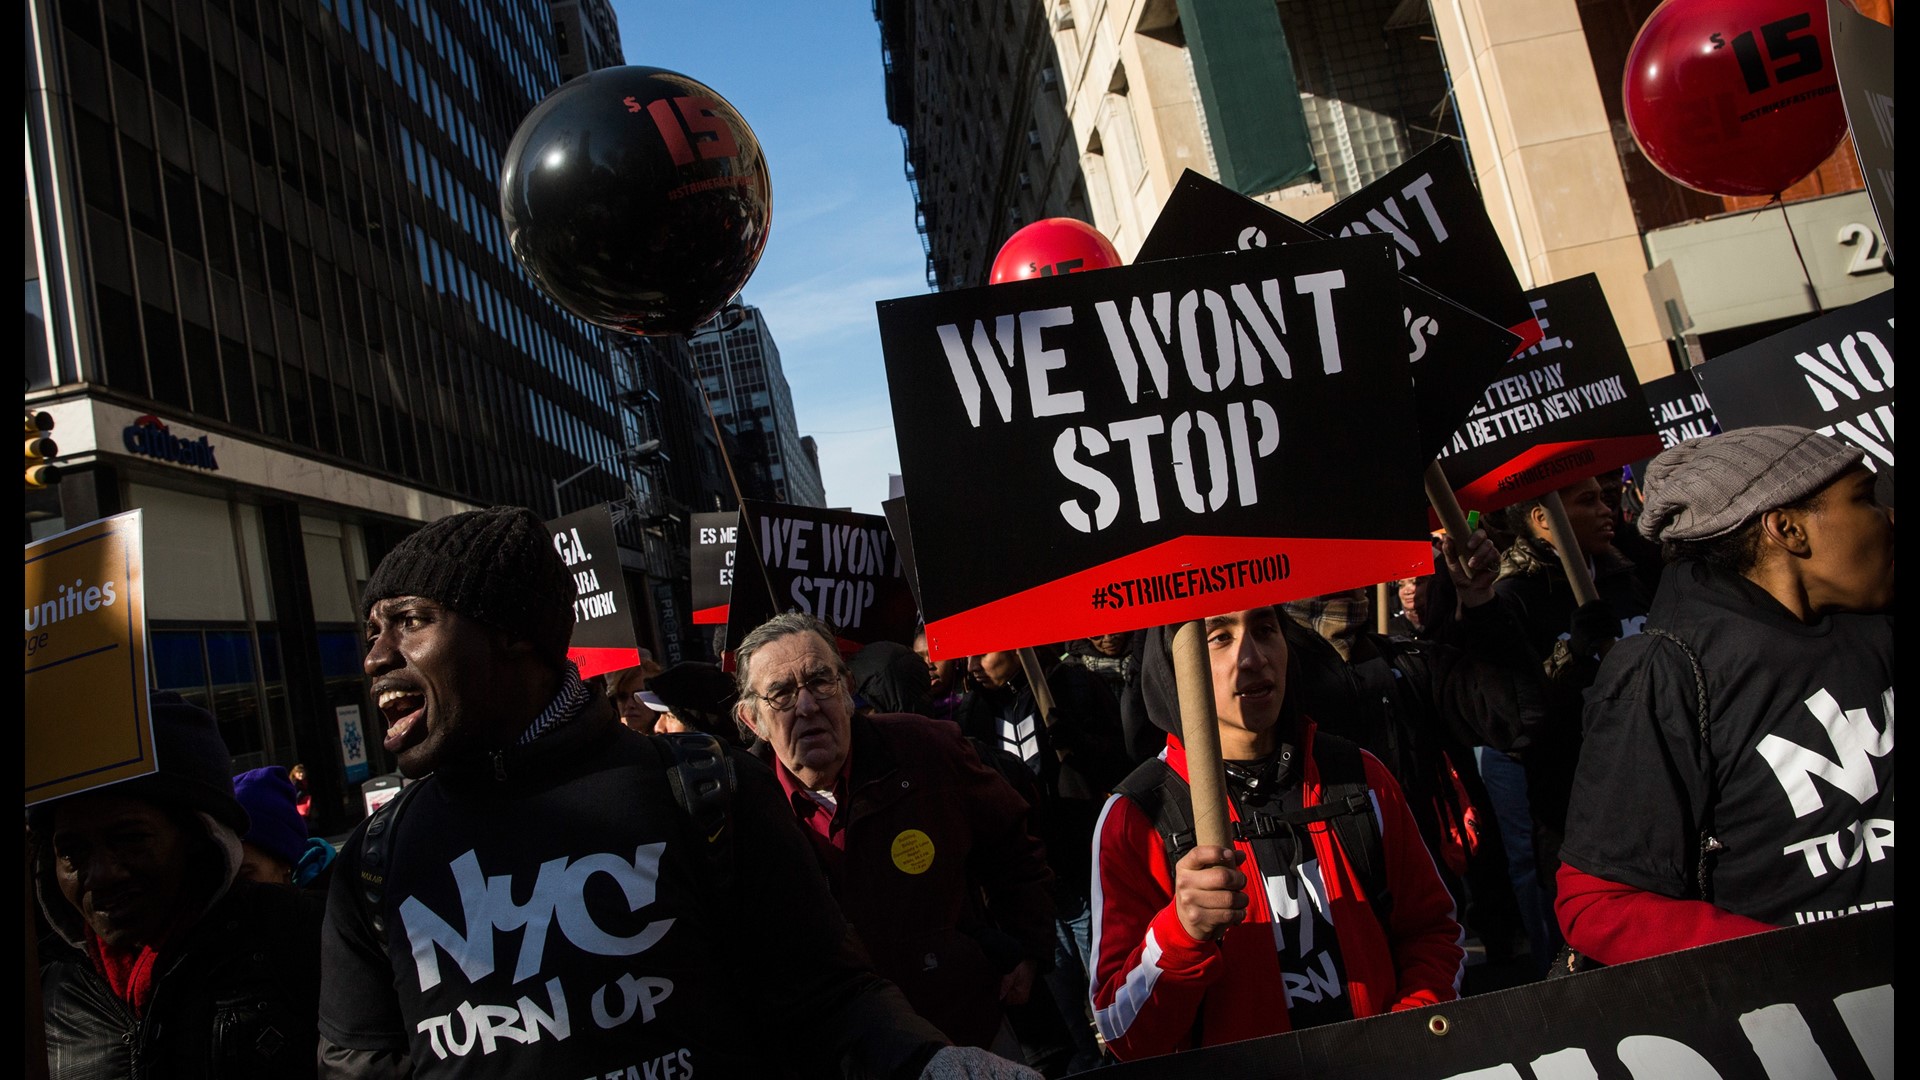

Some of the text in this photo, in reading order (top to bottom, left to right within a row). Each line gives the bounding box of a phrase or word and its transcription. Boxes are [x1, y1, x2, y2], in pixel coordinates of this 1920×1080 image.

[937, 306, 1085, 428] WE
[1529, 362, 1566, 395] PAY
[1452, 430, 1468, 454] A
[1466, 402, 1543, 448] BETTER
[1541, 386, 1587, 422] NEW
[1582, 375, 1628, 409] YORK
[1660, 398, 1694, 424] ALL
[1680, 418, 1712, 441] ALL
[1053, 400, 1280, 533] STOP
[1497, 450, 1595, 490] #STRIKEFASTFOOD
[700, 528, 717, 545] ES
[760, 516, 814, 570] WE
[579, 591, 617, 621] YORK
[790, 575, 875, 629] STOP
[1092, 554, 1290, 610] #STRIKEFASTFOOD
[25, 632, 48, 656] ge
[399, 842, 678, 993] NYC
[417, 972, 674, 1060] TURN UP
